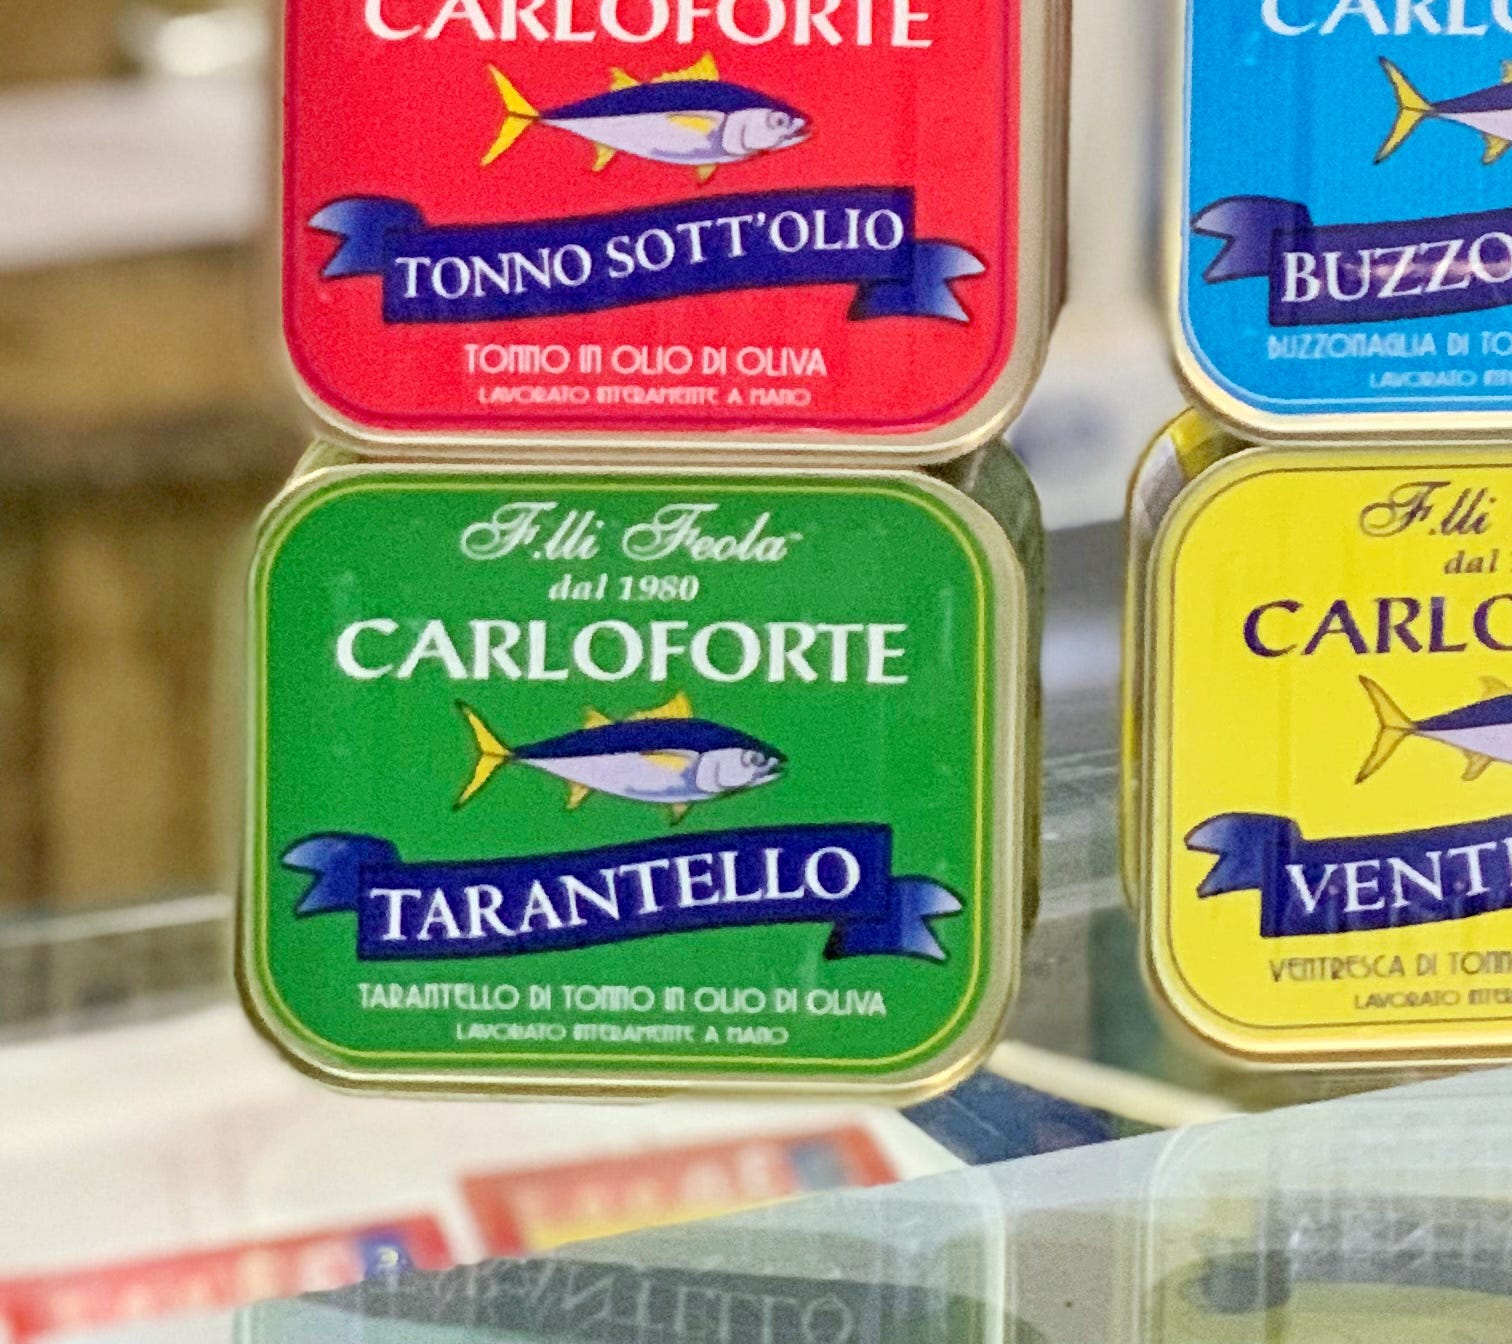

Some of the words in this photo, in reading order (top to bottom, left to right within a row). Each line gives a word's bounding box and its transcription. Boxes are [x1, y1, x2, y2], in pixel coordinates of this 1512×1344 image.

[394, 245, 592, 301] TONNO
[606, 206, 905, 282] SOTT'OLIO
[1447, 331, 1470, 356] DI
[465, 344, 571, 375] TONNO
[579, 344, 602, 375] IN
[611, 345, 693, 376] OLIO
[701, 346, 727, 376] DI
[736, 347, 828, 378] OLIVA
[479, 385, 590, 405] LAVORATO
[727, 387, 743, 406] A
[621, 503, 788, 564] Feola
[1443, 549, 1499, 576] dal
[548, 573, 607, 601] dal
[619, 574, 699, 602] 1980
[335, 618, 908, 685] CARLOFORTE
[369, 845, 861, 943] TARANTELLO
[1269, 954, 1406, 982] VENTRESCA
[1416, 952, 1438, 977] DI
[358, 982, 520, 1010] TARANTELLO
[529, 984, 551, 1010] DI
[561, 984, 655, 1012] TONNO
[694, 986, 766, 1014] OLIO
[776, 987, 798, 1014] DI
[807, 988, 887, 1016] OLIVA
[705, 1025, 719, 1044] A
